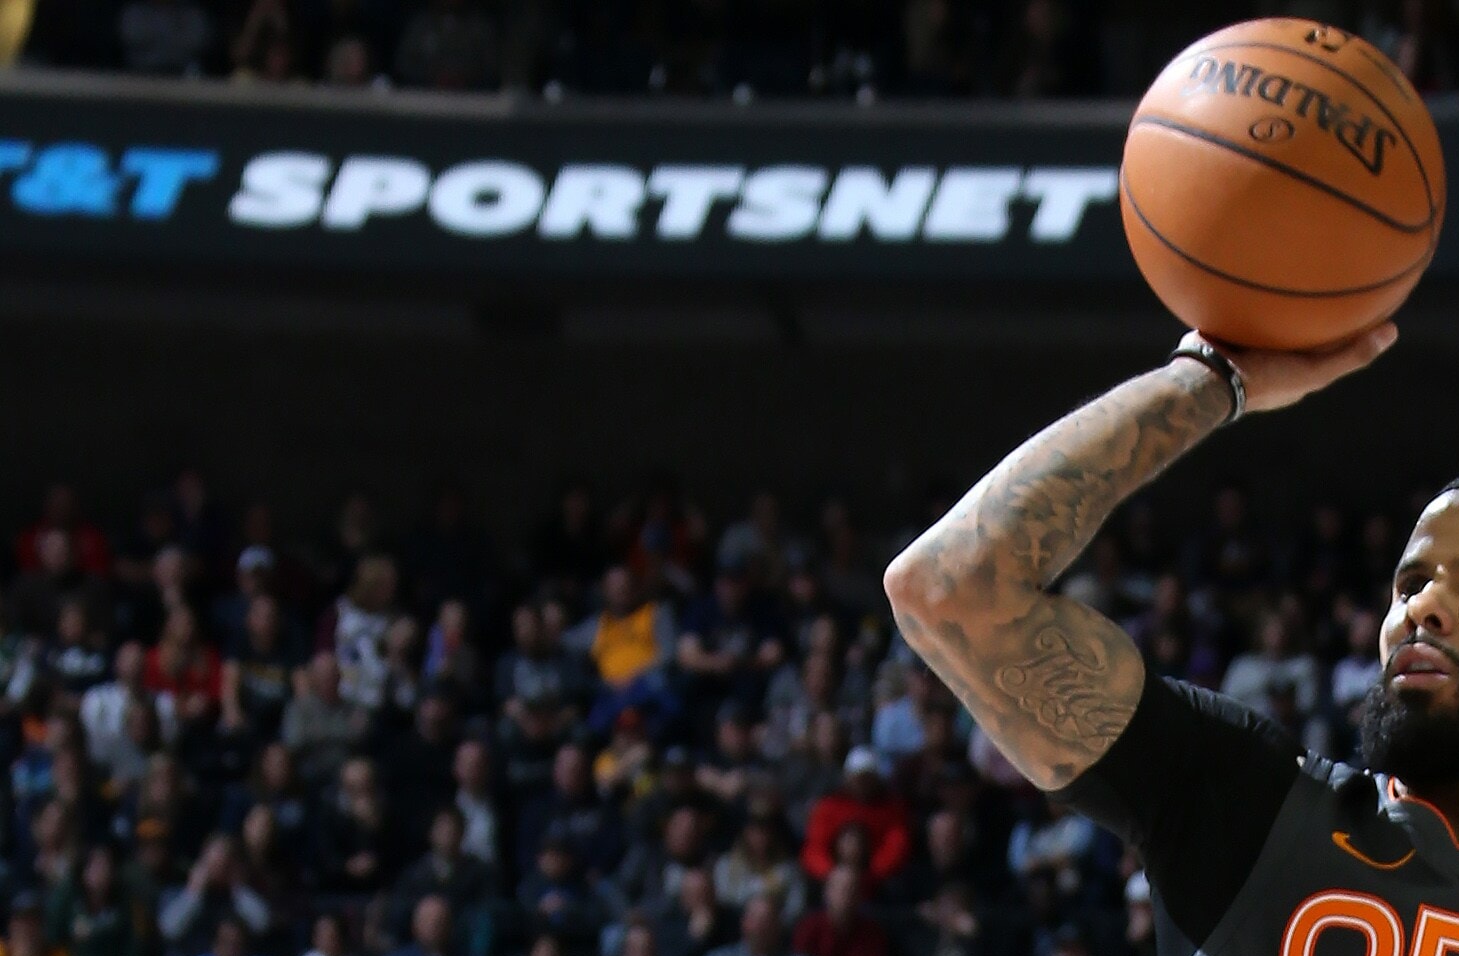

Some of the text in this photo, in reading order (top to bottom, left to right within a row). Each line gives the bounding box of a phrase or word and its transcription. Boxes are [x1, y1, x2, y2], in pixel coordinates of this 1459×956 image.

[1182, 55, 1397, 176] SPALDING
[0, 140, 1119, 242] &T SPORTSNET
